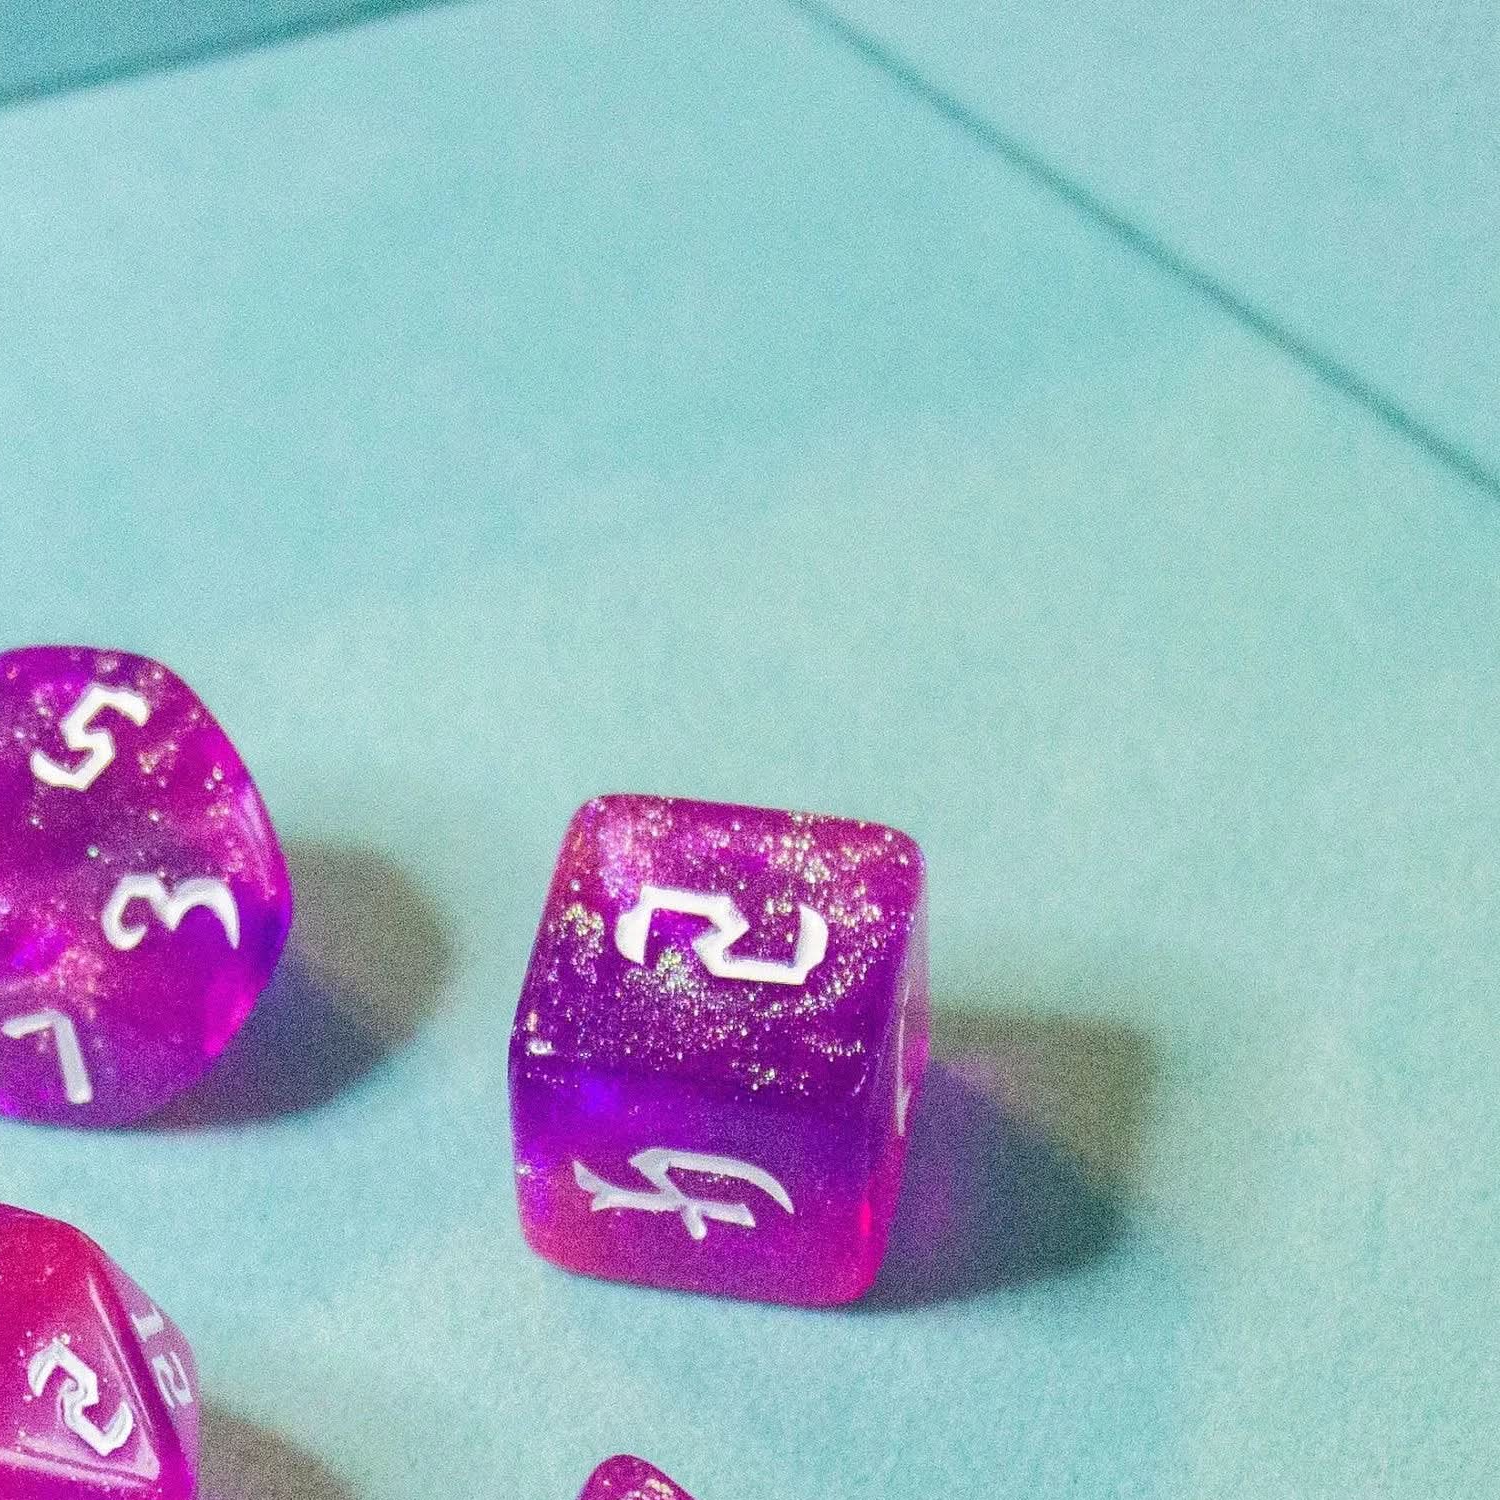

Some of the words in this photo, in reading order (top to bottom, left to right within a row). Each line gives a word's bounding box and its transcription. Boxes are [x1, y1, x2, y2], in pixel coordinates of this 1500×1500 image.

[31, 684, 151, 791] 5
[103, 874, 240, 950] 3
[615, 885, 829, 985] 2
[2, 1009, 92, 1104] 7
[572, 1148, 793, 1240] 4
[27, 1338, 134, 1456] 2
